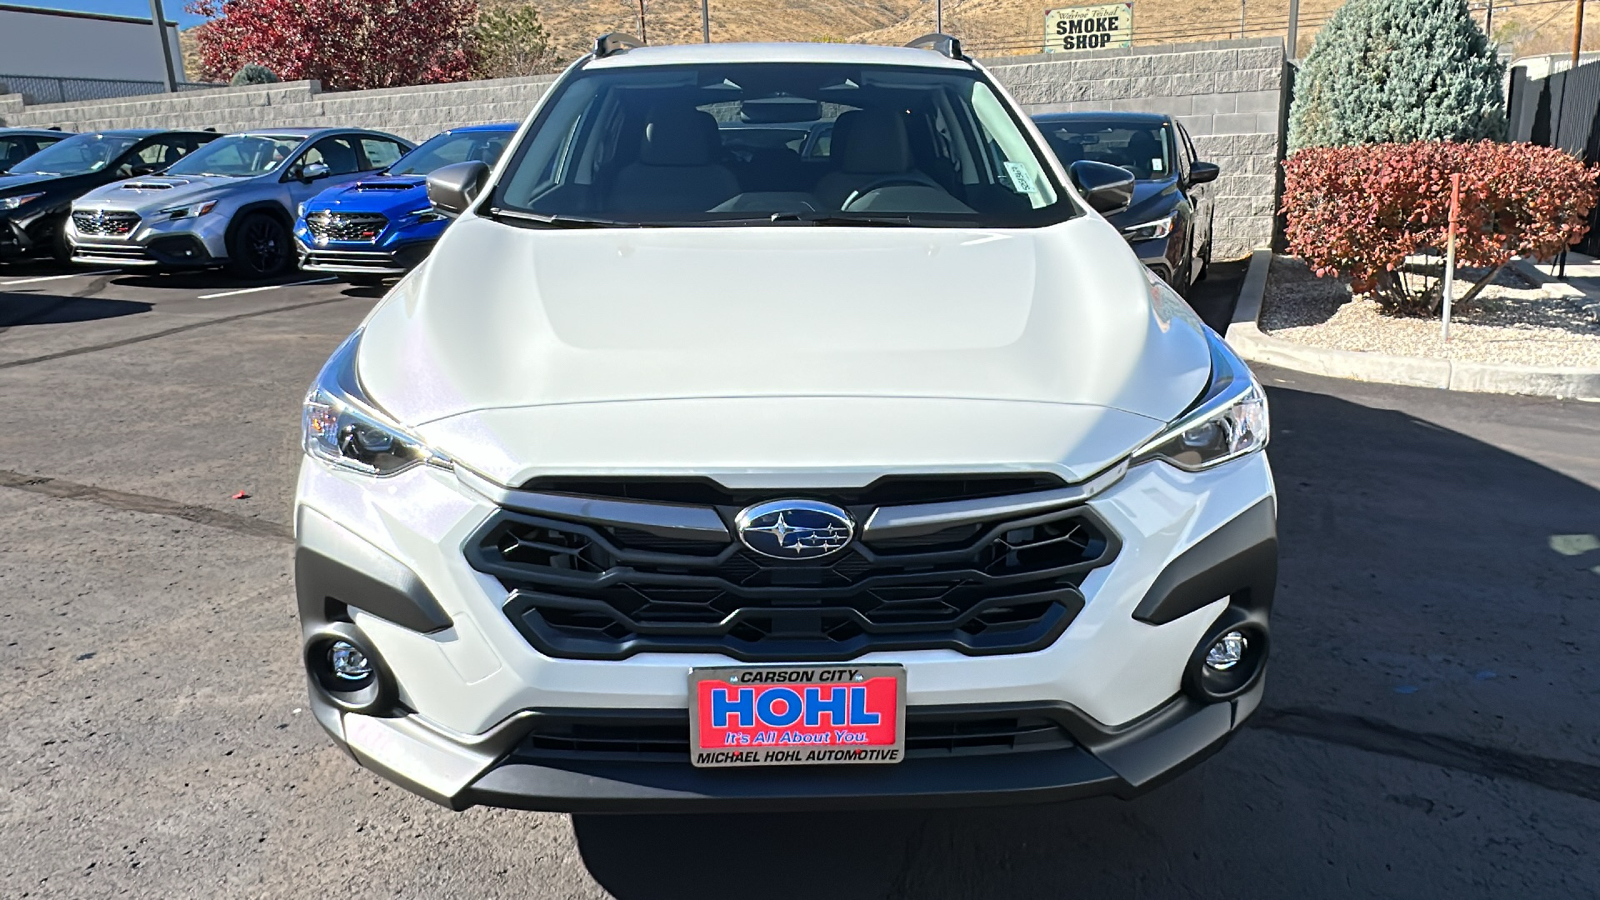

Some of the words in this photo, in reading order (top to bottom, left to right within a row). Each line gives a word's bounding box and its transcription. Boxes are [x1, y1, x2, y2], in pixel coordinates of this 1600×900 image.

[1056, 16, 1119, 35] SMOKE
[1063, 33, 1111, 50] SHOP
[740, 670, 815, 683] CARSON
[818, 669, 859, 682] CITY
[711, 686, 881, 728] HOHL
[725, 731, 750, 745] It's
[752, 731, 777, 744] All
[779, 730, 831, 744] About
[697, 751, 760, 764] MICHAEL
[764, 750, 802, 762] HOHL
[805, 749, 899, 761] AUTOMOTIVE
